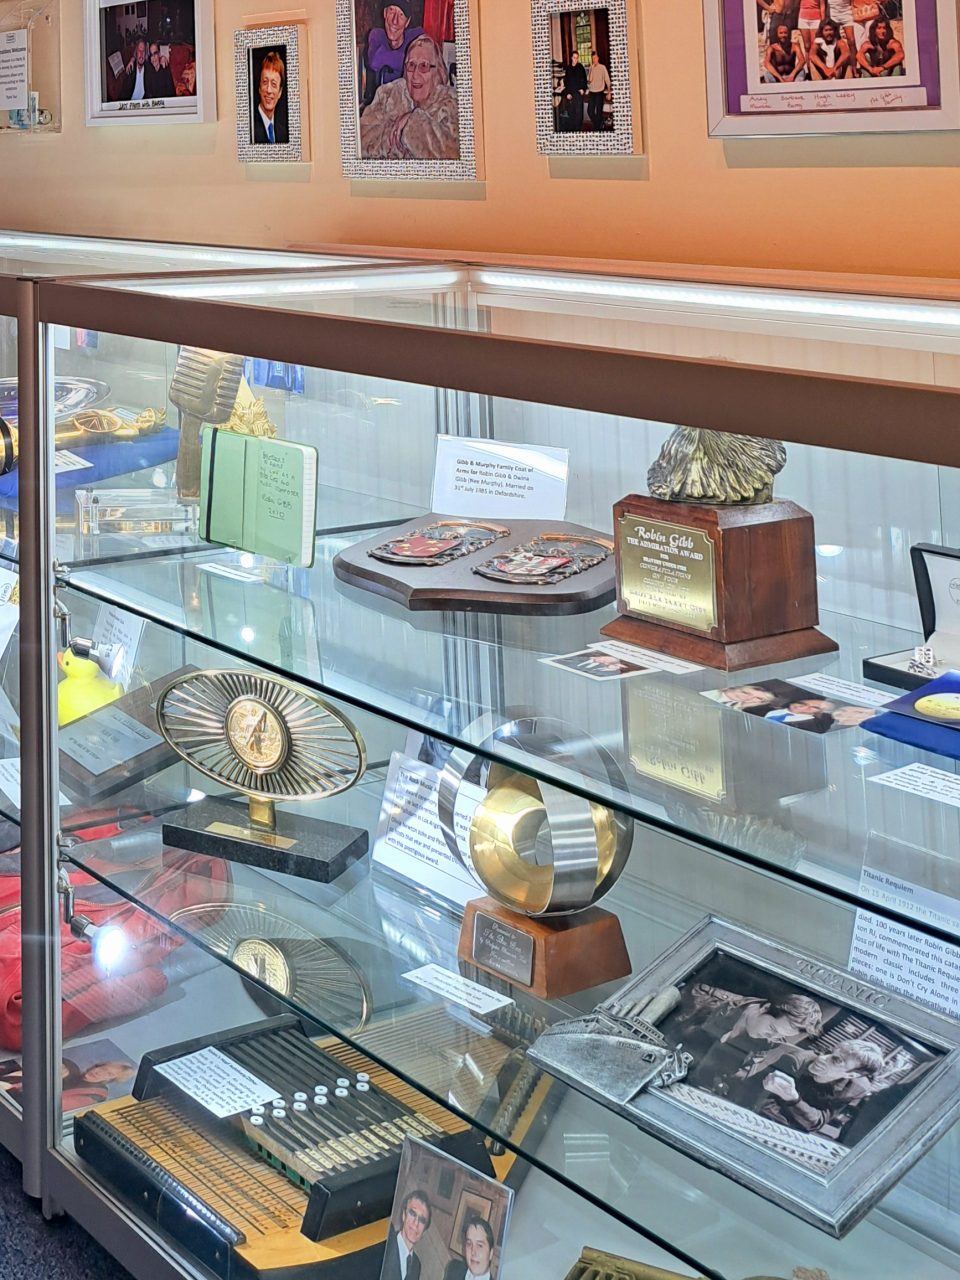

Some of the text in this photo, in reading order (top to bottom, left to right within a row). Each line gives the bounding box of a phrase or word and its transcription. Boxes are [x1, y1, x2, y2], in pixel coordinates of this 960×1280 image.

[475, 461, 496, 469] Murphy
[480, 479, 503, 487] Murphy).
[505, 482, 526, 490] Married
[494, 489, 525, 498] Oxfordshire.
[627, 537, 704, 560] THE ADMIRATION AWARD
[634, 526, 694, 550] Robin Gibb
[863, 869, 913, 894] Titanic Requiem
[857, 925, 867, 933] son
[878, 933, 929, 958] commemorated
[931, 953, 942, 964] this
[858, 914, 873, 924] died.
[876, 919, 887, 929] 100
[888, 925, 905, 937] years
[907, 931, 923, 943] later
[924, 938, 943, 952] Robin
[855, 934, 866, 944] loss
[875, 942, 885, 952] life
[886, 948, 900, 958] with
[901, 952, 913, 963] The
[915, 958, 936, 973] Titanic
[854, 946, 958, 993] modern classic includes three
